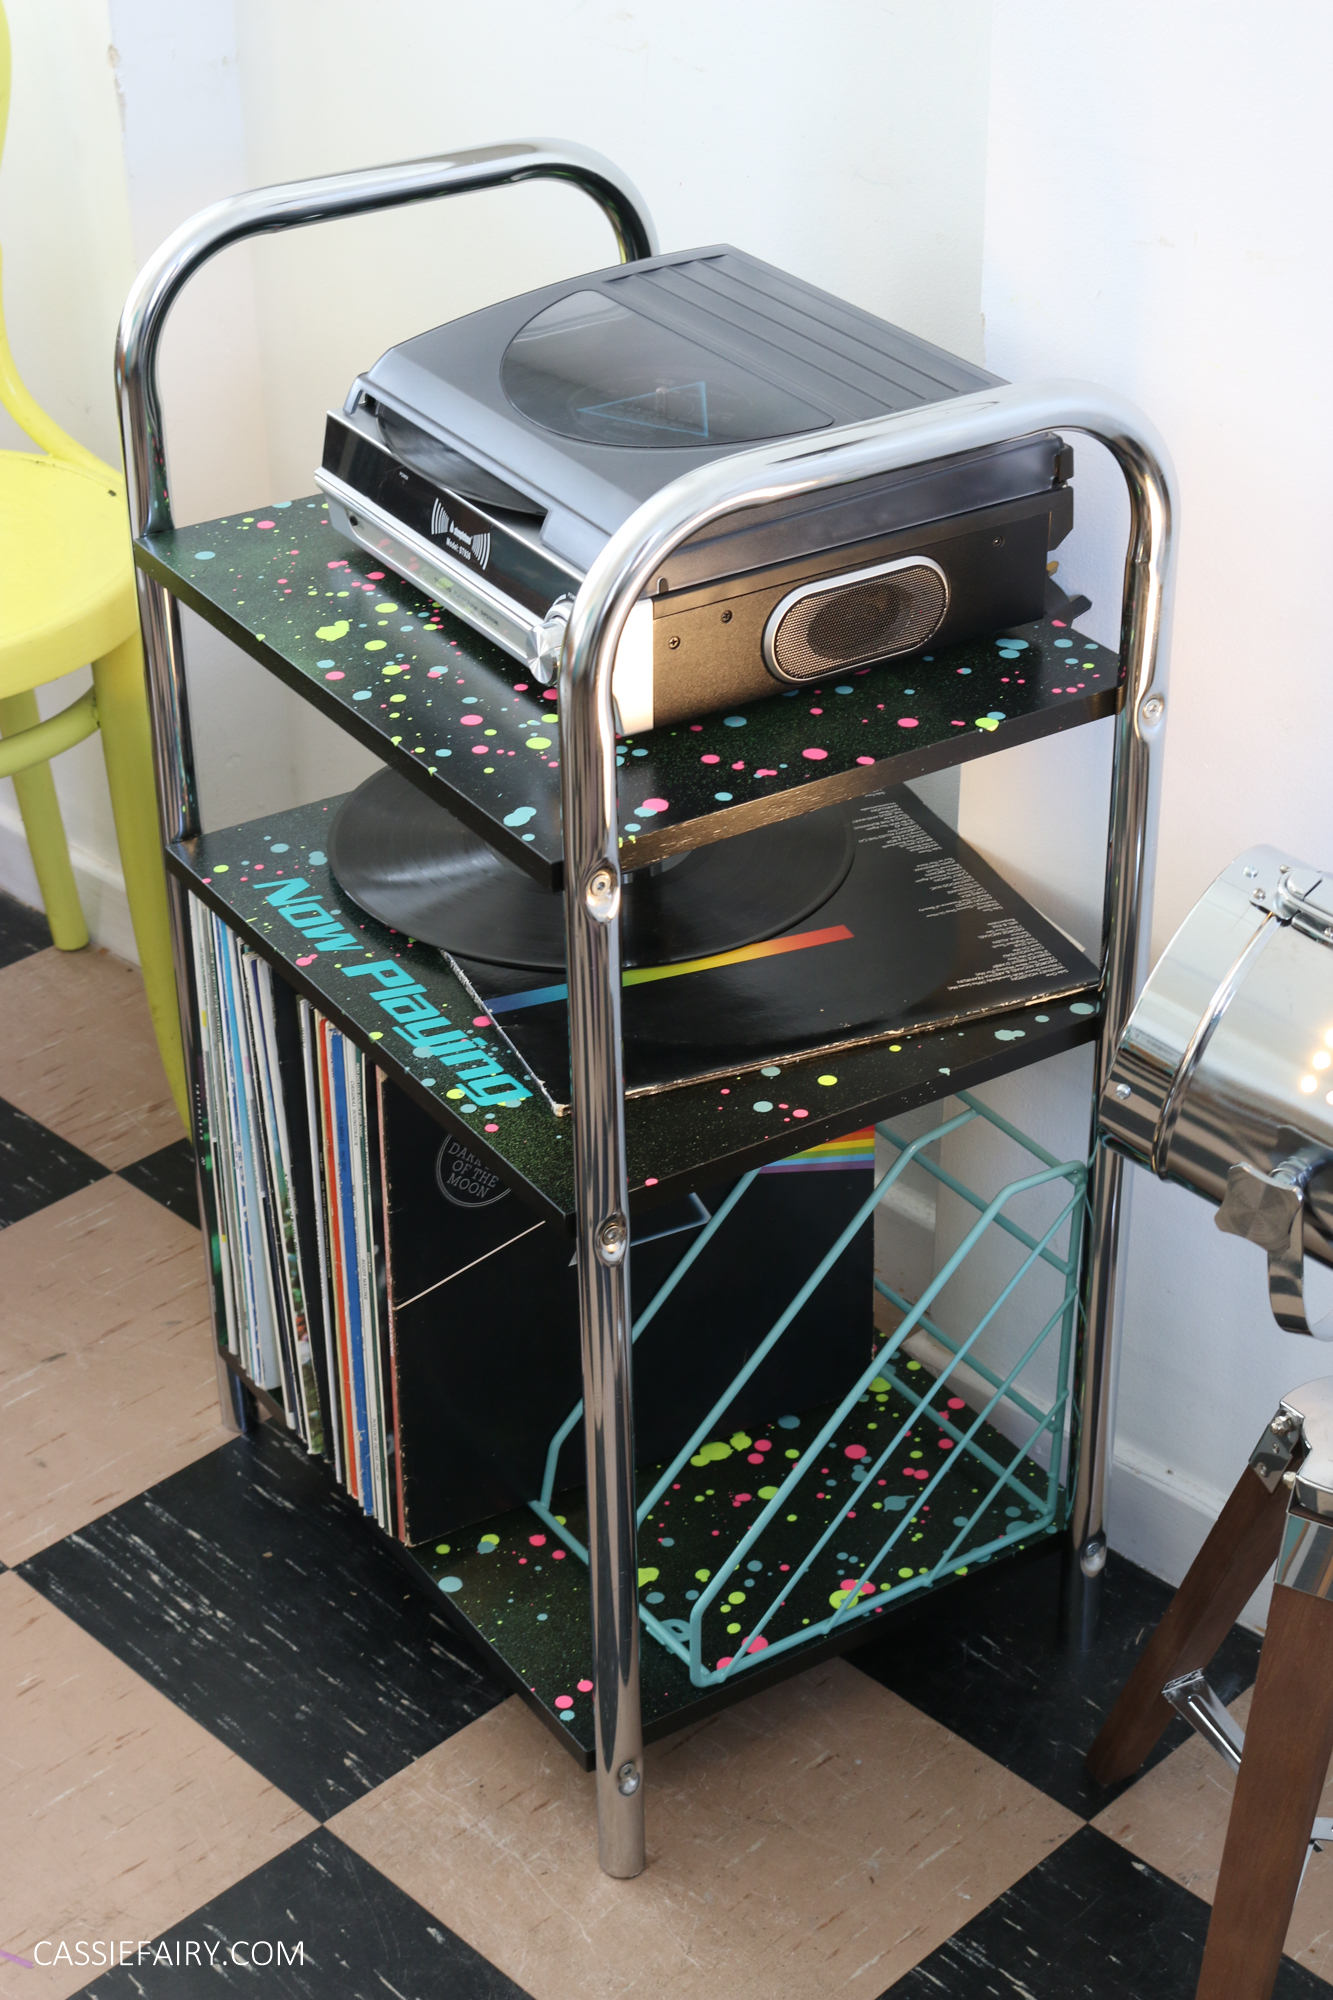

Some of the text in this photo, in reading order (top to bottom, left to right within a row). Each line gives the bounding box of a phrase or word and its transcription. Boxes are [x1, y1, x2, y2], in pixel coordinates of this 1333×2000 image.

[341, 959, 533, 1106] Playing
[446, 1172, 490, 1198] MOON
[452, 1160, 500, 1188] OF THE
